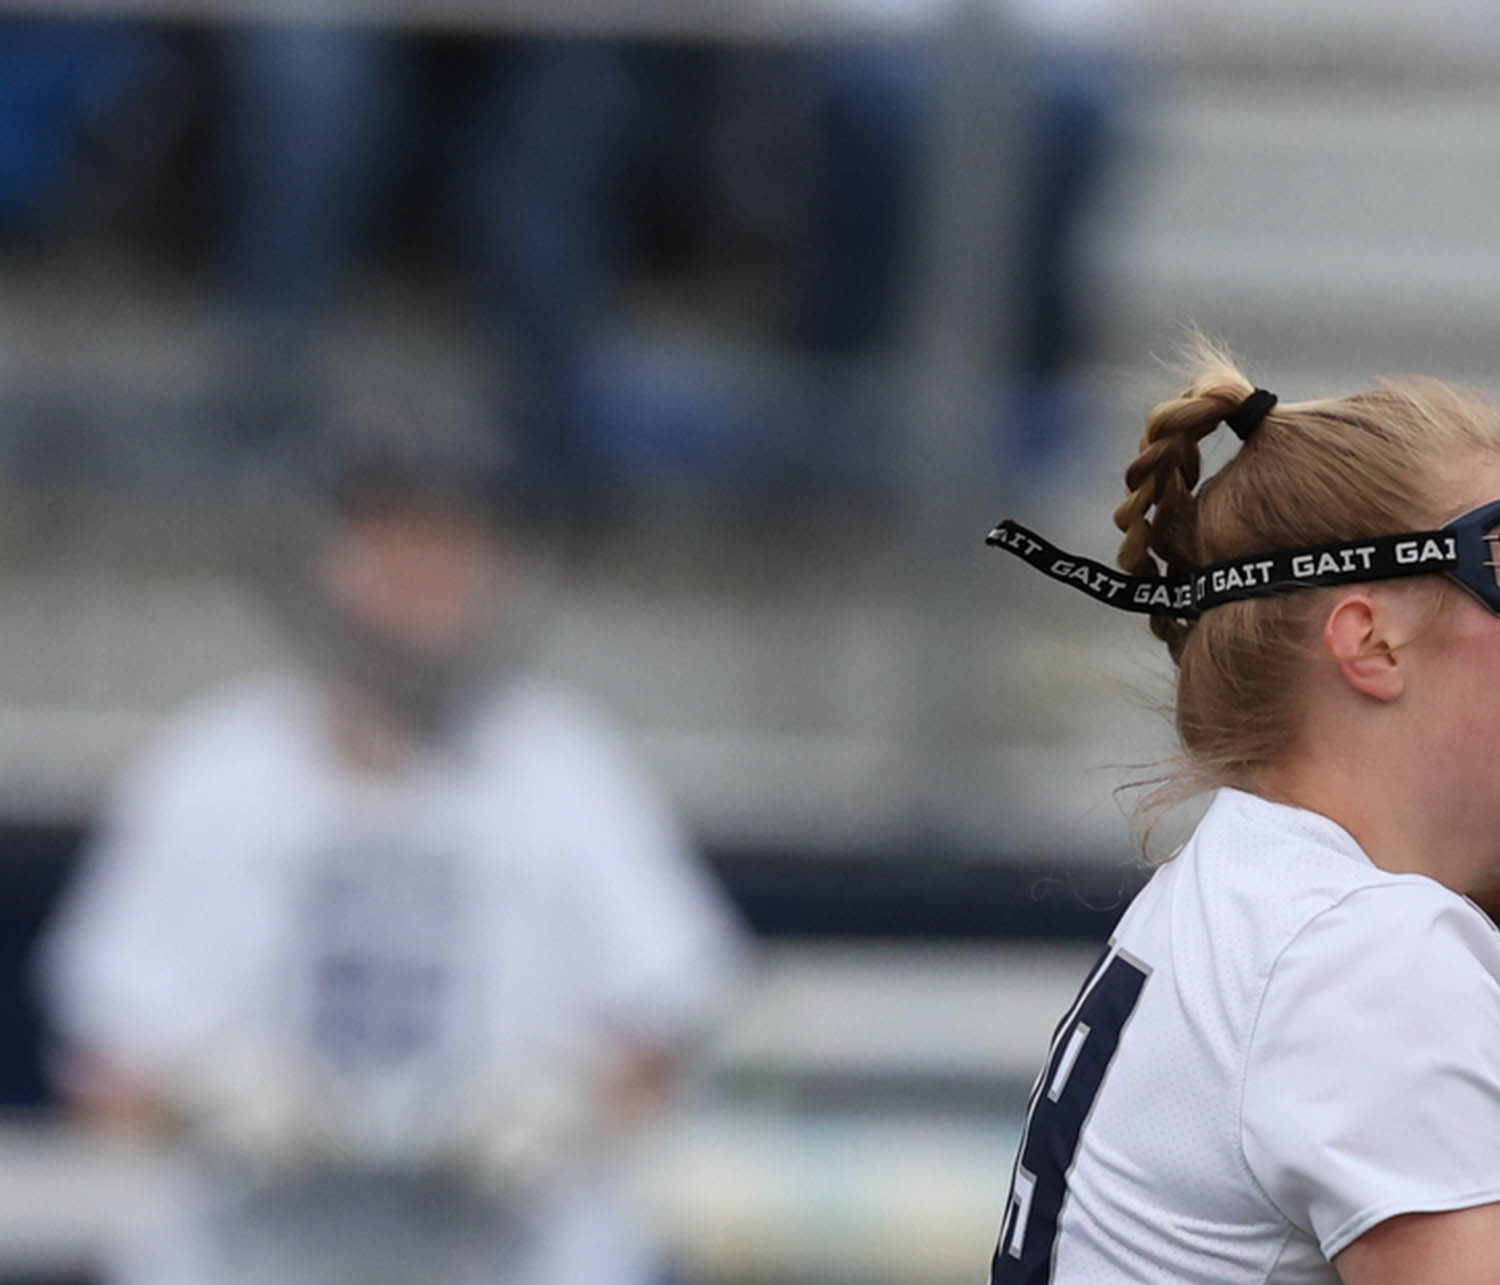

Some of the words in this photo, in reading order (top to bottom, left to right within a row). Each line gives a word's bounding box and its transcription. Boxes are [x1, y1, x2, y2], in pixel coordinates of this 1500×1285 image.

[988, 528, 1043, 555] AIT
[1050, 559, 1127, 598] GAIT
[1211, 560, 1274, 593] GAIT
[1291, 546, 1376, 578] GAIT
[1395, 538, 1457, 564] GAI
